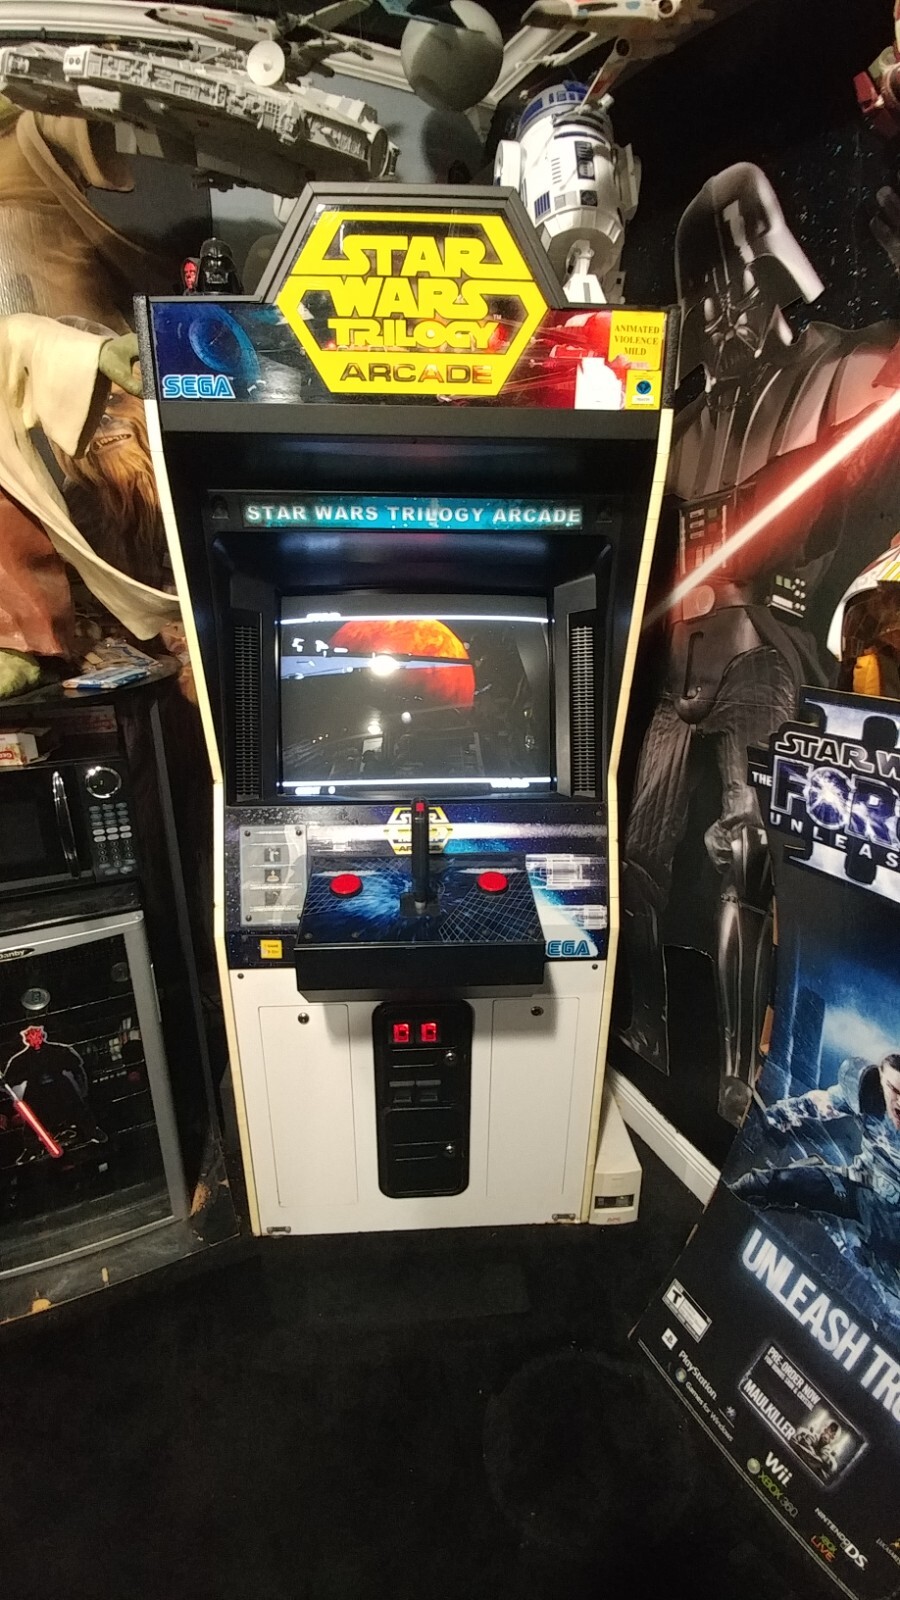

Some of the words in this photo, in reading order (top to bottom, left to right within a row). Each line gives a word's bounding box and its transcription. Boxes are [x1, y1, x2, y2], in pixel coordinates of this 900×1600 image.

[326, 234, 498, 277] STAR
[328, 275, 490, 320] WARS
[327, 318, 500, 349] TRILOGY
[614, 324, 660, 335] ANIMATED
[614, 335, 659, 345] VIOLENCE
[624, 346, 647, 356] MILD
[162, 374, 236, 398] SEGA
[340, 362, 493, 384] ARCADE
[247, 505, 307, 520] STAR
[314, 505, 378, 521] WARS
[387, 506, 484, 522] TRILOGY
[493, 507, 582, 523] ARCADE
[774, 731, 875, 774] STAR
[752, 771, 772, 787] THE
[770, 755, 900, 853] FOR
[546, 940, 591, 956] EGA
[742, 1228, 870, 1371] UNLEASH
[860, 1344, 900, 1424] TR
[679, 1350, 718, 1401] PlayStation
[767, 1346, 805, 1387] PRE-ORDER
[802, 1385, 822, 1405] NOW
[743, 1379, 797, 1440] MAULKILLER
[765, 1451, 793, 1487] Wii
[758, 1470, 783, 1500] XBOX
[780, 1496, 798, 1518] 360
[810, 1535, 836, 1562] LIVE
[845, 1543, 868, 1569] DS
